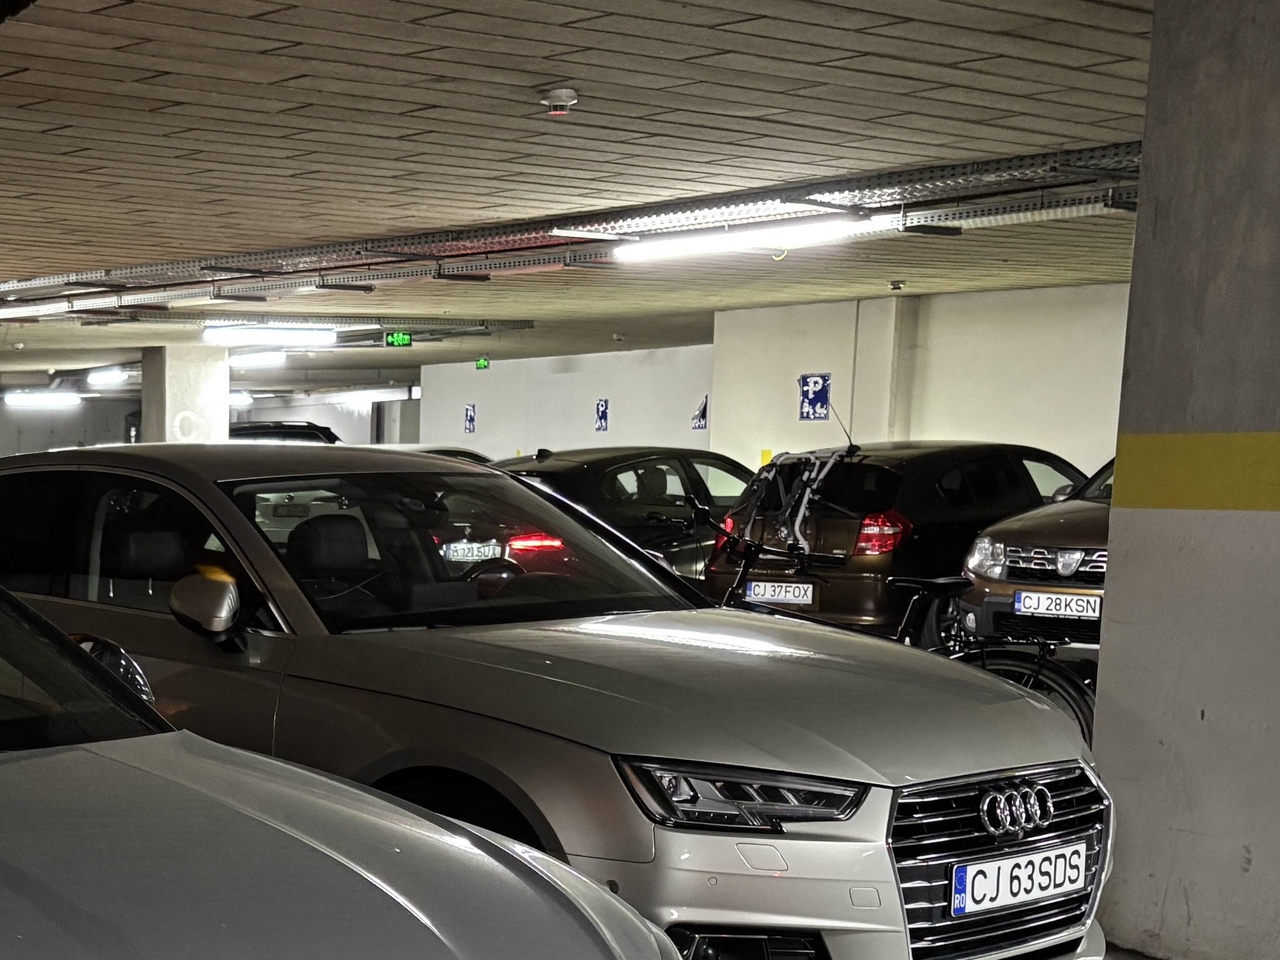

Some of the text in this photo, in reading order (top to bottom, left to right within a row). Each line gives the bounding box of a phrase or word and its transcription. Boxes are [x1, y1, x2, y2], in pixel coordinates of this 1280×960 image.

[753, 584, 767, 597] CJ
[1023, 595, 1040, 610] CJ
[954, 893, 966, 908] RO
[971, 866, 1001, 905] CJ
